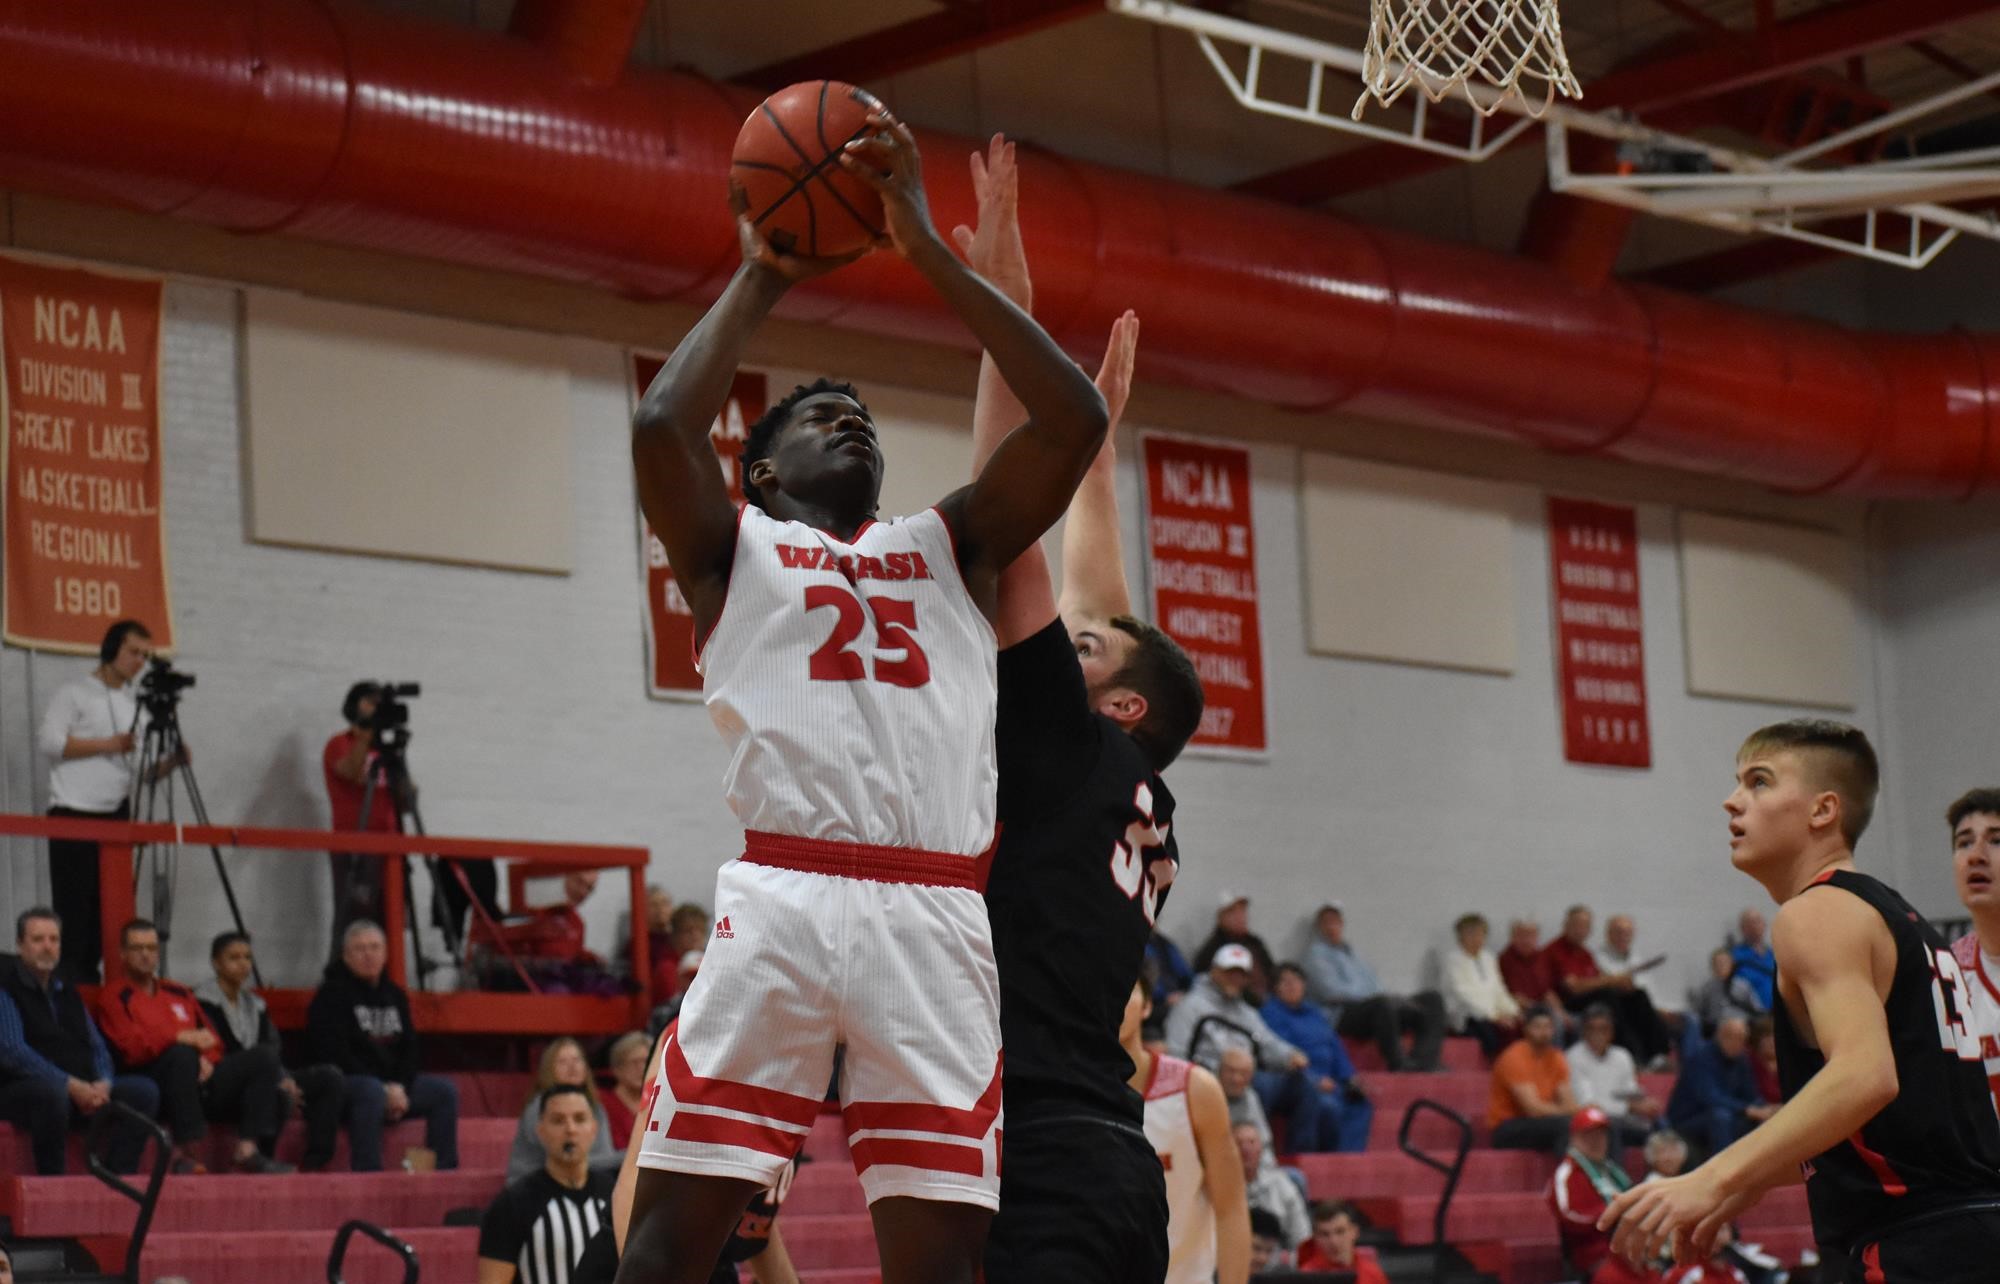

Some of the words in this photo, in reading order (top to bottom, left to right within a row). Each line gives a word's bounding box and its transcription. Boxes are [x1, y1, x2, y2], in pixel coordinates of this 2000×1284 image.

[34, 296, 126, 354] NCAA
[20, 358, 106, 405] DIVISION
[121, 373, 143, 410] III
[87, 420, 150, 463] LAKES
[1162, 459, 1234, 511] NCAA
[32, 519, 141, 570] REGIONAL
[54, 576, 122, 618] 1980
[805, 584, 931, 688] 25
